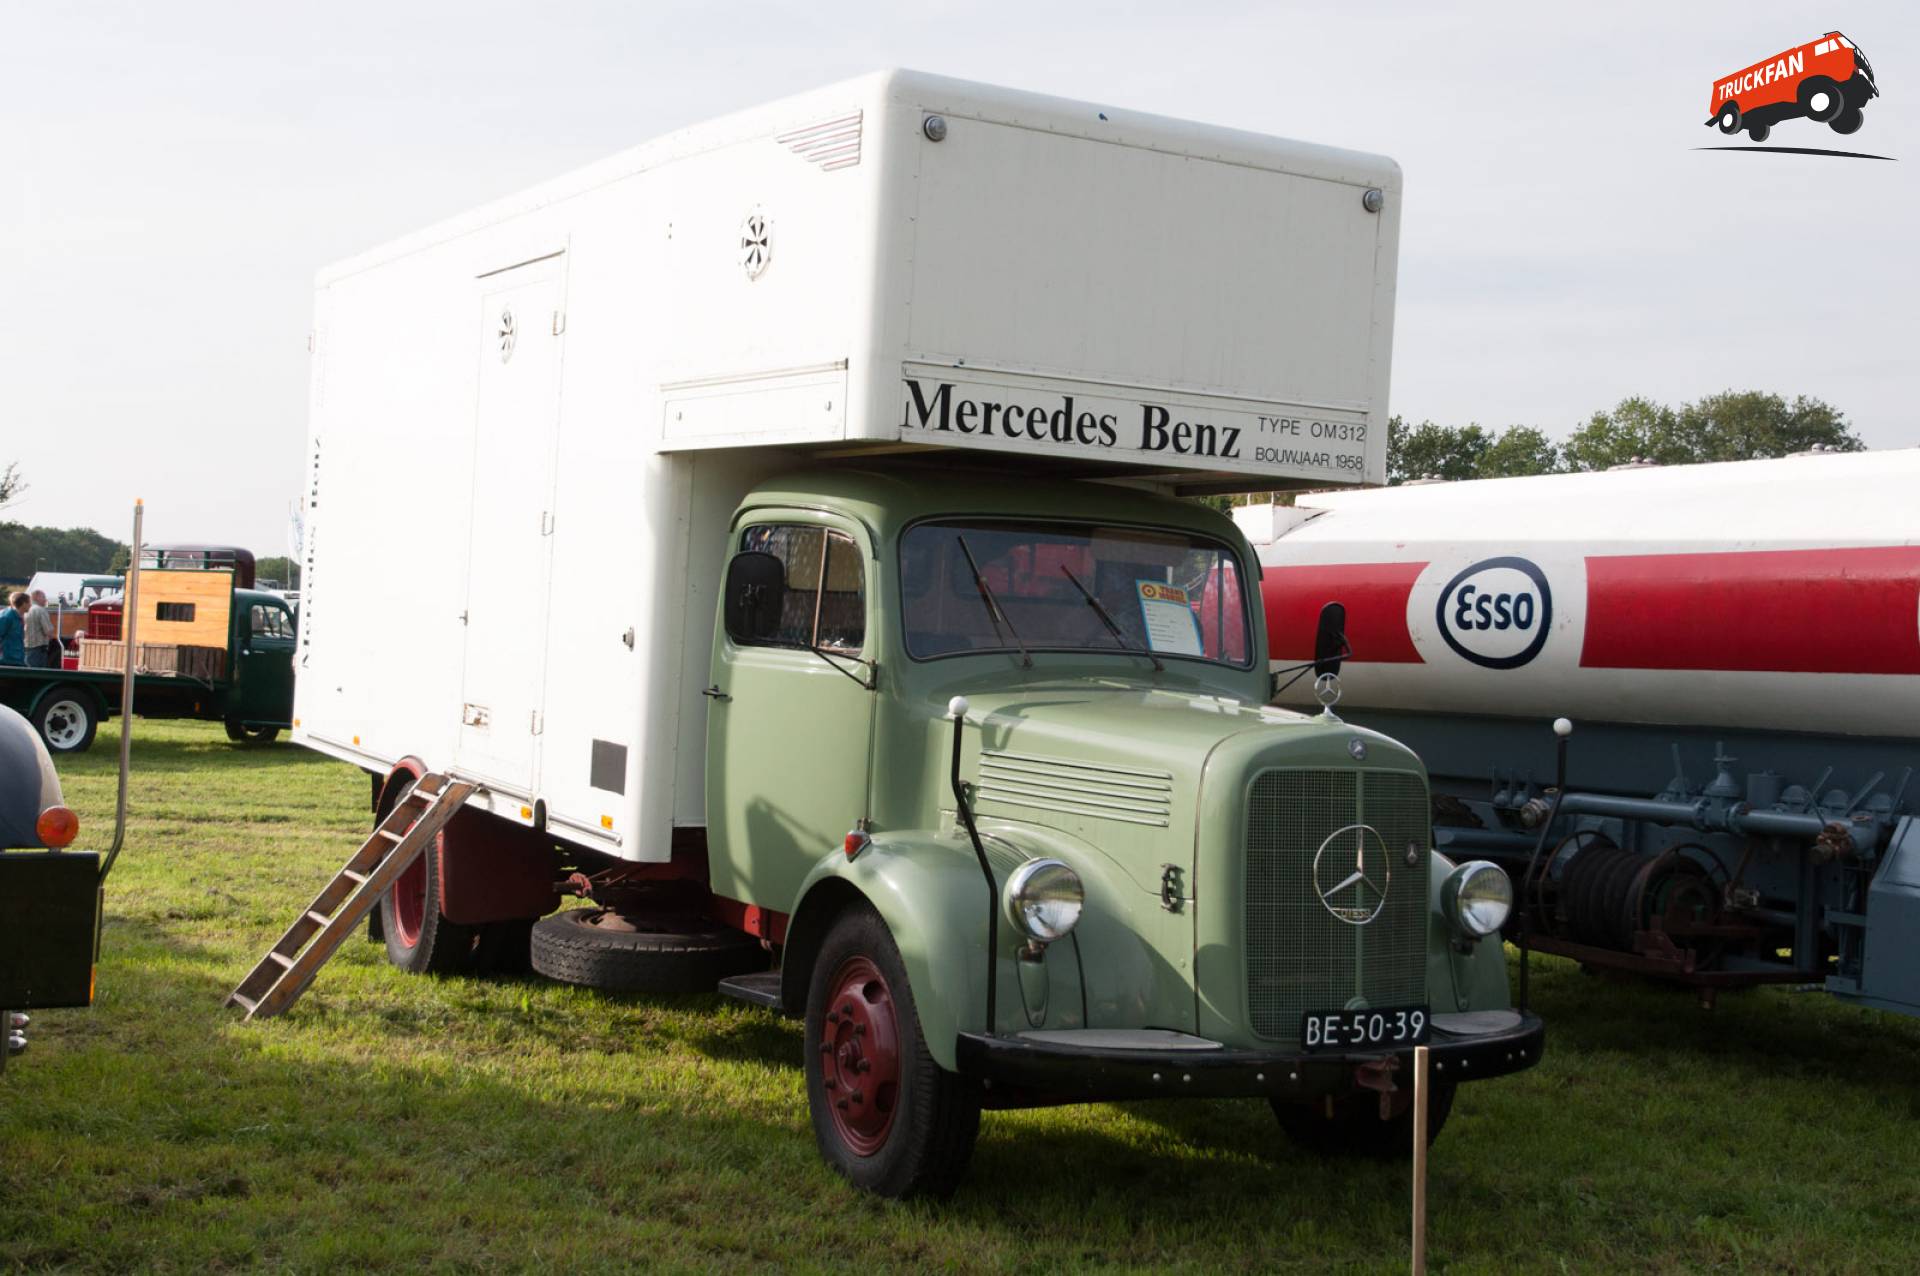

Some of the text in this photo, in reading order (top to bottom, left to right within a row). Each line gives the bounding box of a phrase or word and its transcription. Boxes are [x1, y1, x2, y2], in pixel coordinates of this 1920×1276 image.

[899, 379, 1242, 459] Mercedes Benz
[1258, 416, 1366, 442] TYPE OM312
[1255, 446, 1363, 470] BOUWJAAR 1958
[1306, 1010, 1425, 1045] BE-50-39
